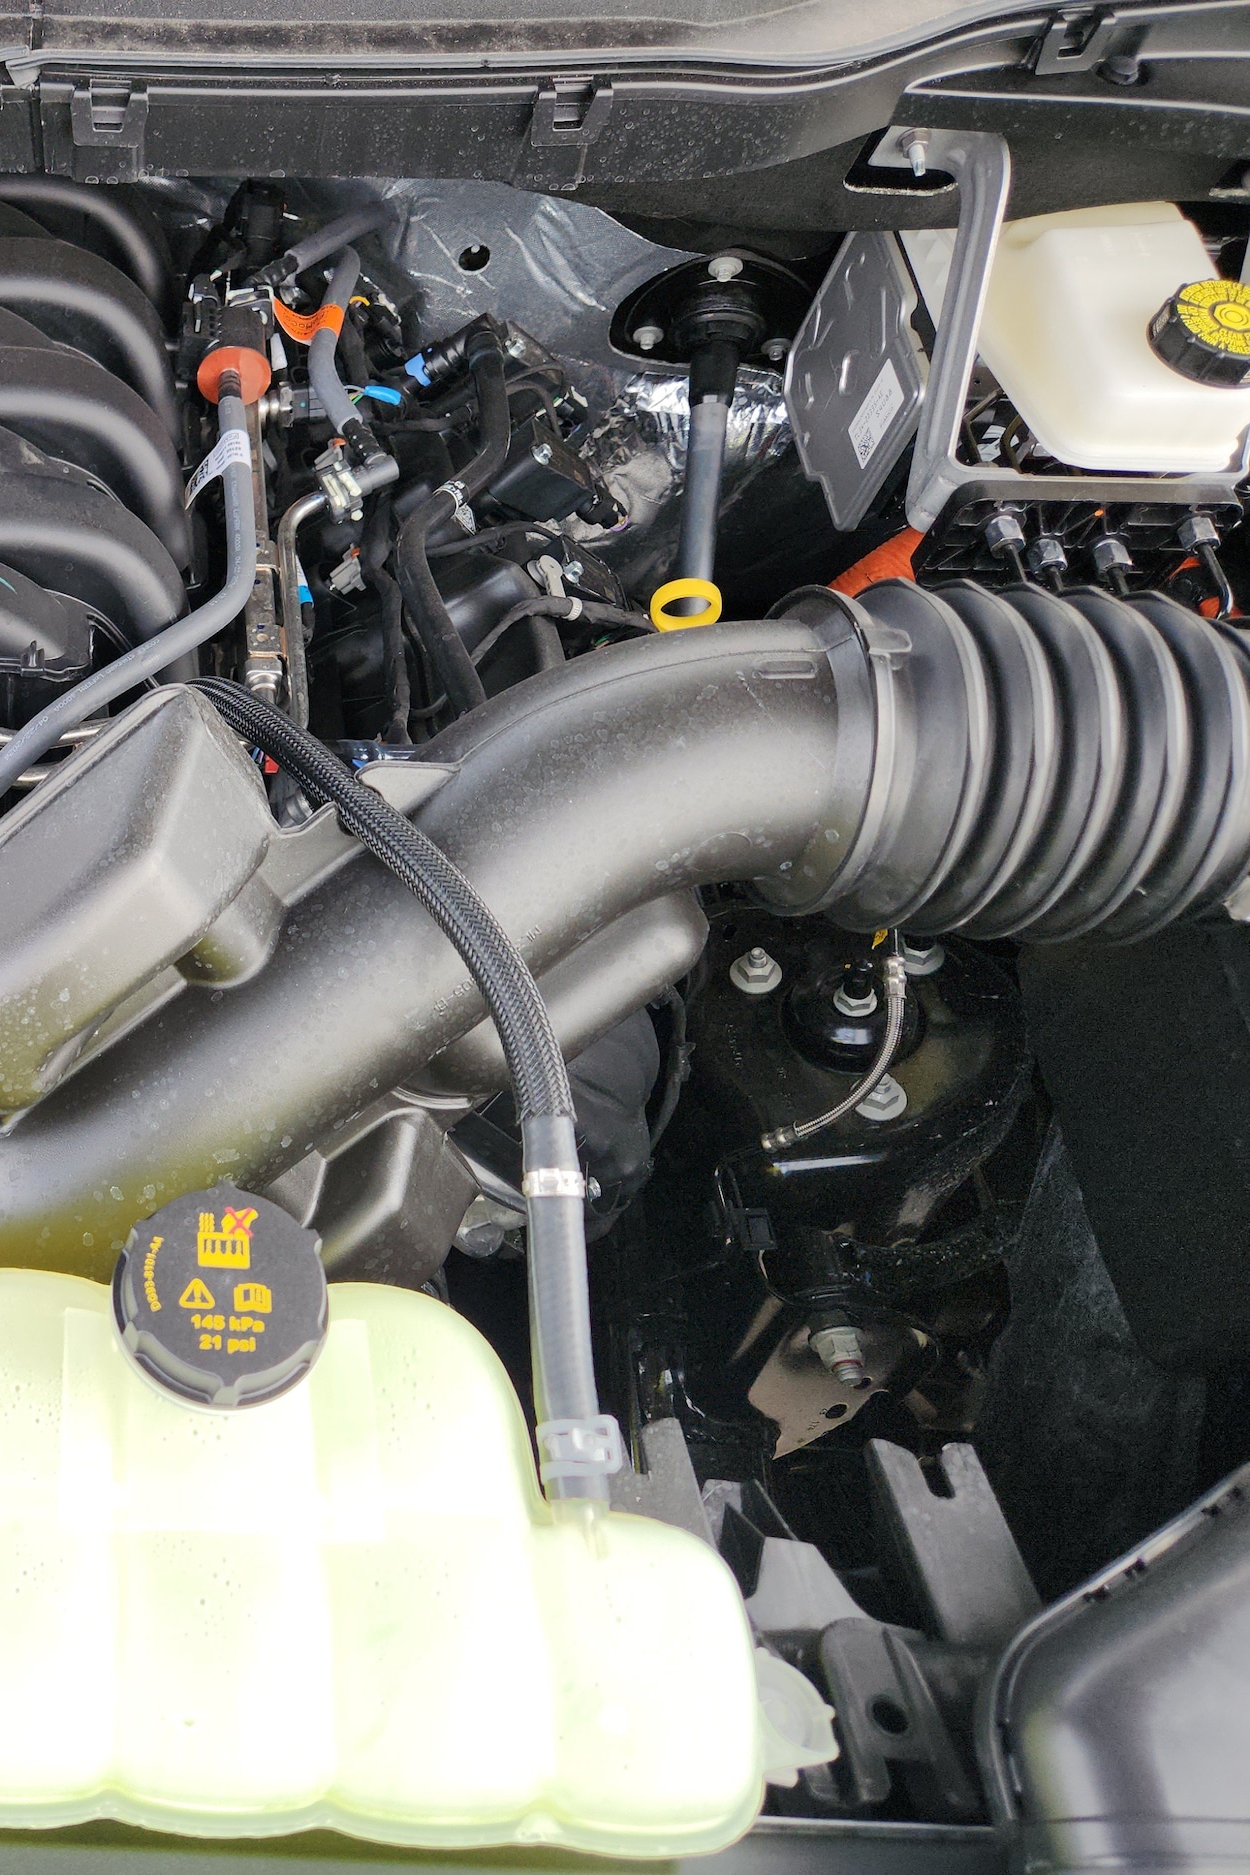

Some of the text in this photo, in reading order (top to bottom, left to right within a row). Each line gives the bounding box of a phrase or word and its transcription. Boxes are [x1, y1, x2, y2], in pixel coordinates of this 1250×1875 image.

[191, 1314, 265, 1333] 145 kPa
[199, 1334, 256, 1354] 21 psi
